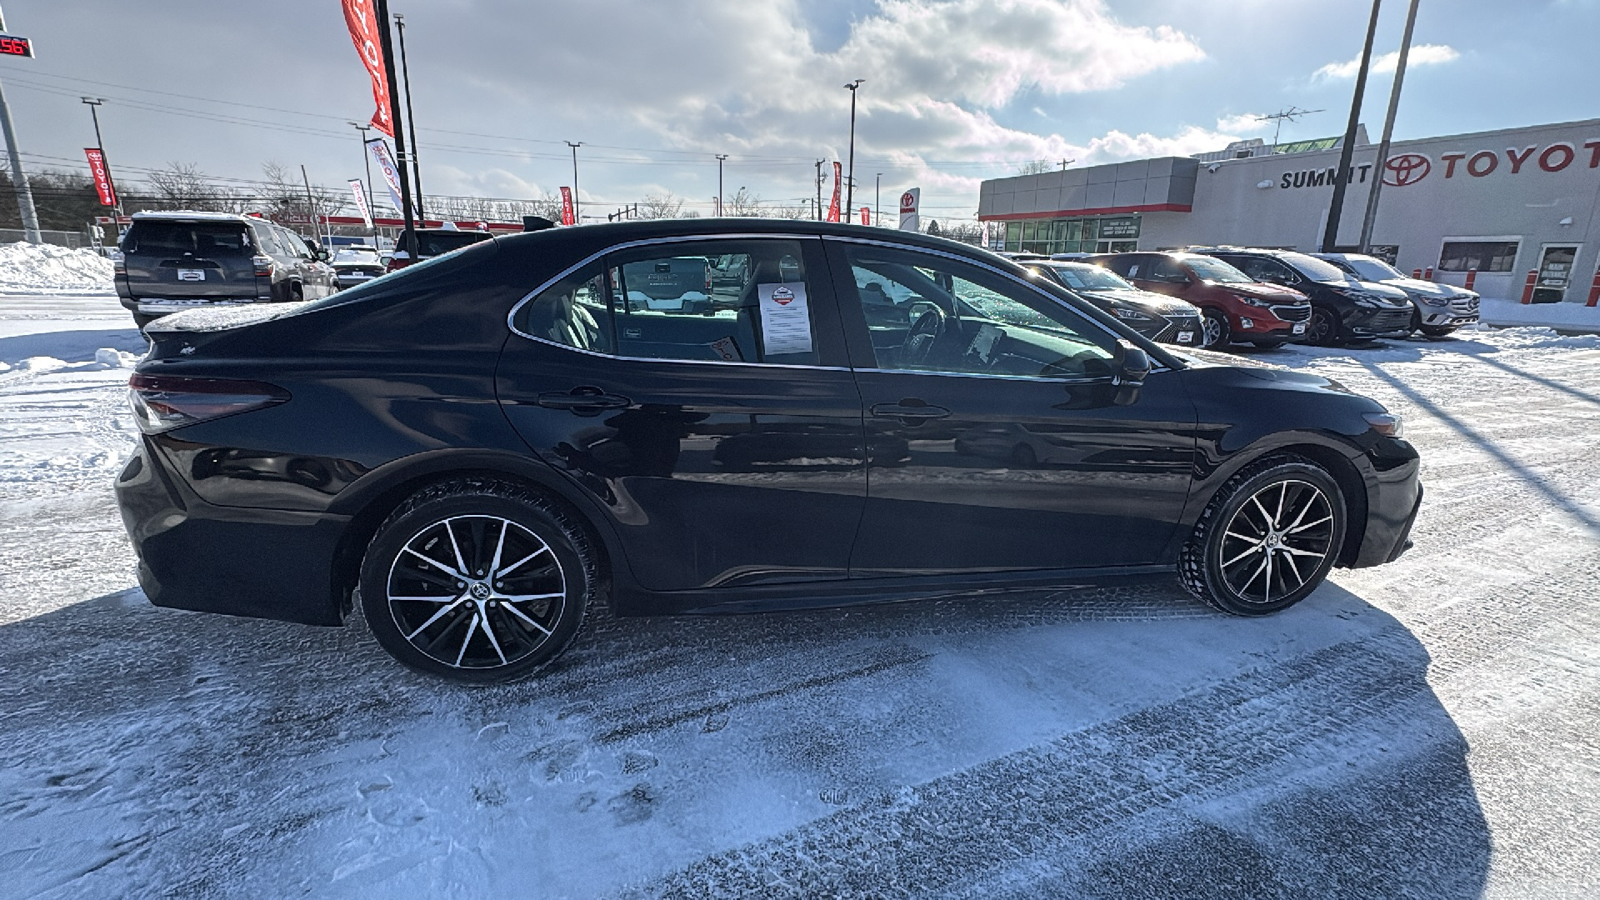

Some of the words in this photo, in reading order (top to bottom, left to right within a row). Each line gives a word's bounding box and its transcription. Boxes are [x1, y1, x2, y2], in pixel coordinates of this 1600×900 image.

[353, 0, 388, 124] YOTA
[94, 161, 112, 203] TOYOTA
[1281, 164, 1372, 189] SUMMIT
